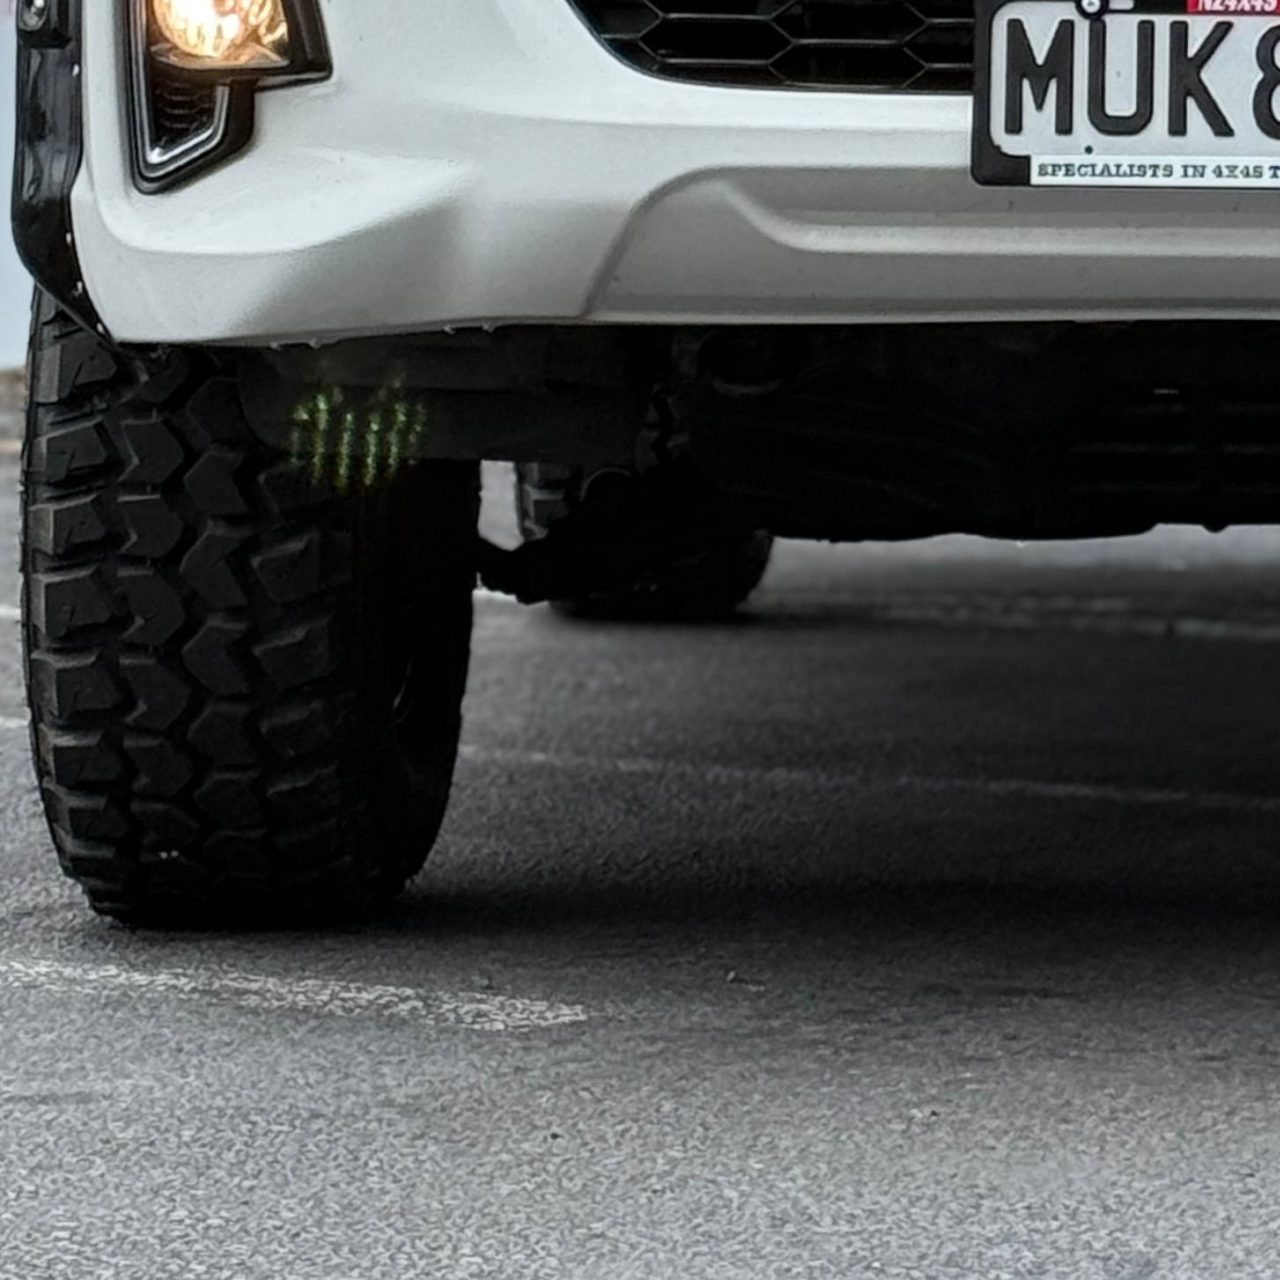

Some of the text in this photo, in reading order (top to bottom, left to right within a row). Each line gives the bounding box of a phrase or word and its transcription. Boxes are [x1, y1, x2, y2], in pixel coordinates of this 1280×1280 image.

[1037, 163, 1174, 178] SPECIALISTS
[1180, 164, 1207, 179] IN
[1211, 165, 1264, 179] 4X4S
